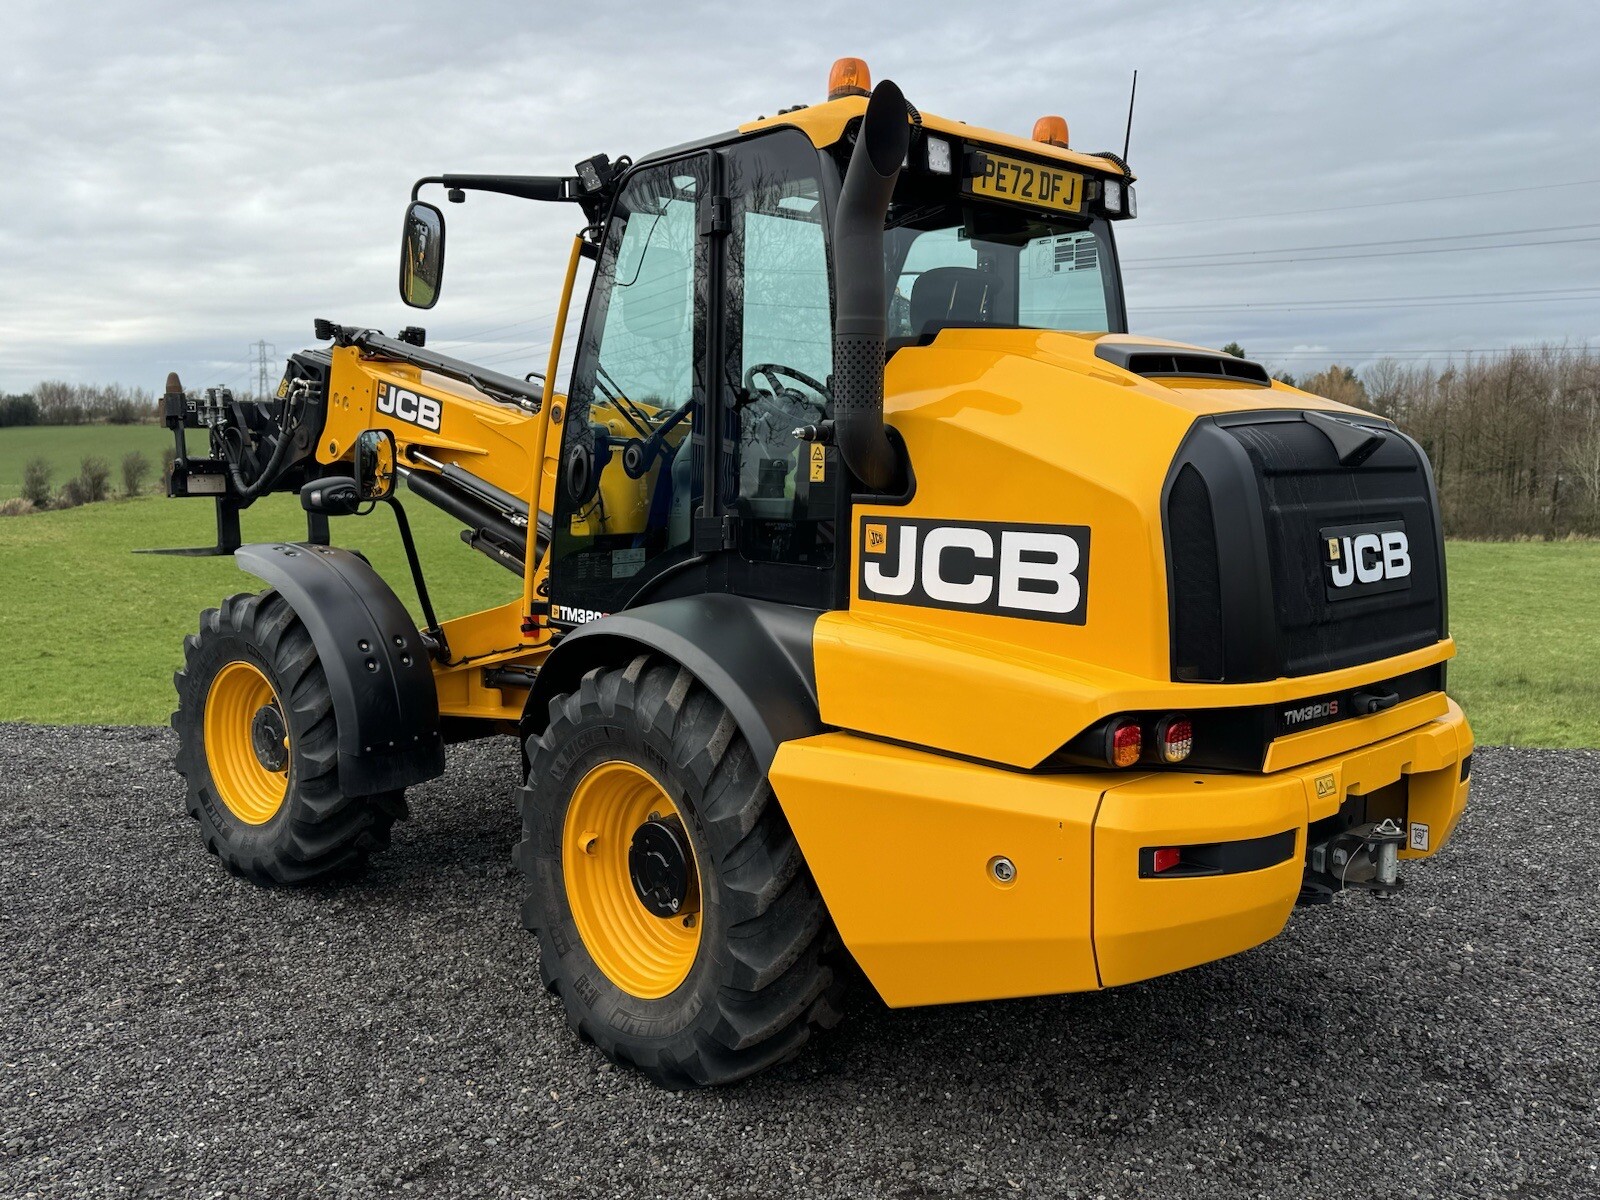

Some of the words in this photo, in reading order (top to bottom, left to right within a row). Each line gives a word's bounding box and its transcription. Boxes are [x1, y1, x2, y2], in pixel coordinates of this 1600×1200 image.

[982, 159, 1034, 198] PE72
[1038, 171, 1075, 206] DFJ
[378, 386, 441, 430] JCB
[864, 525, 1081, 614] JCB
[1331, 531, 1412, 587] JCB
[560, 605, 610, 623] TM320
[1284, 700, 1339, 725] TM320S
